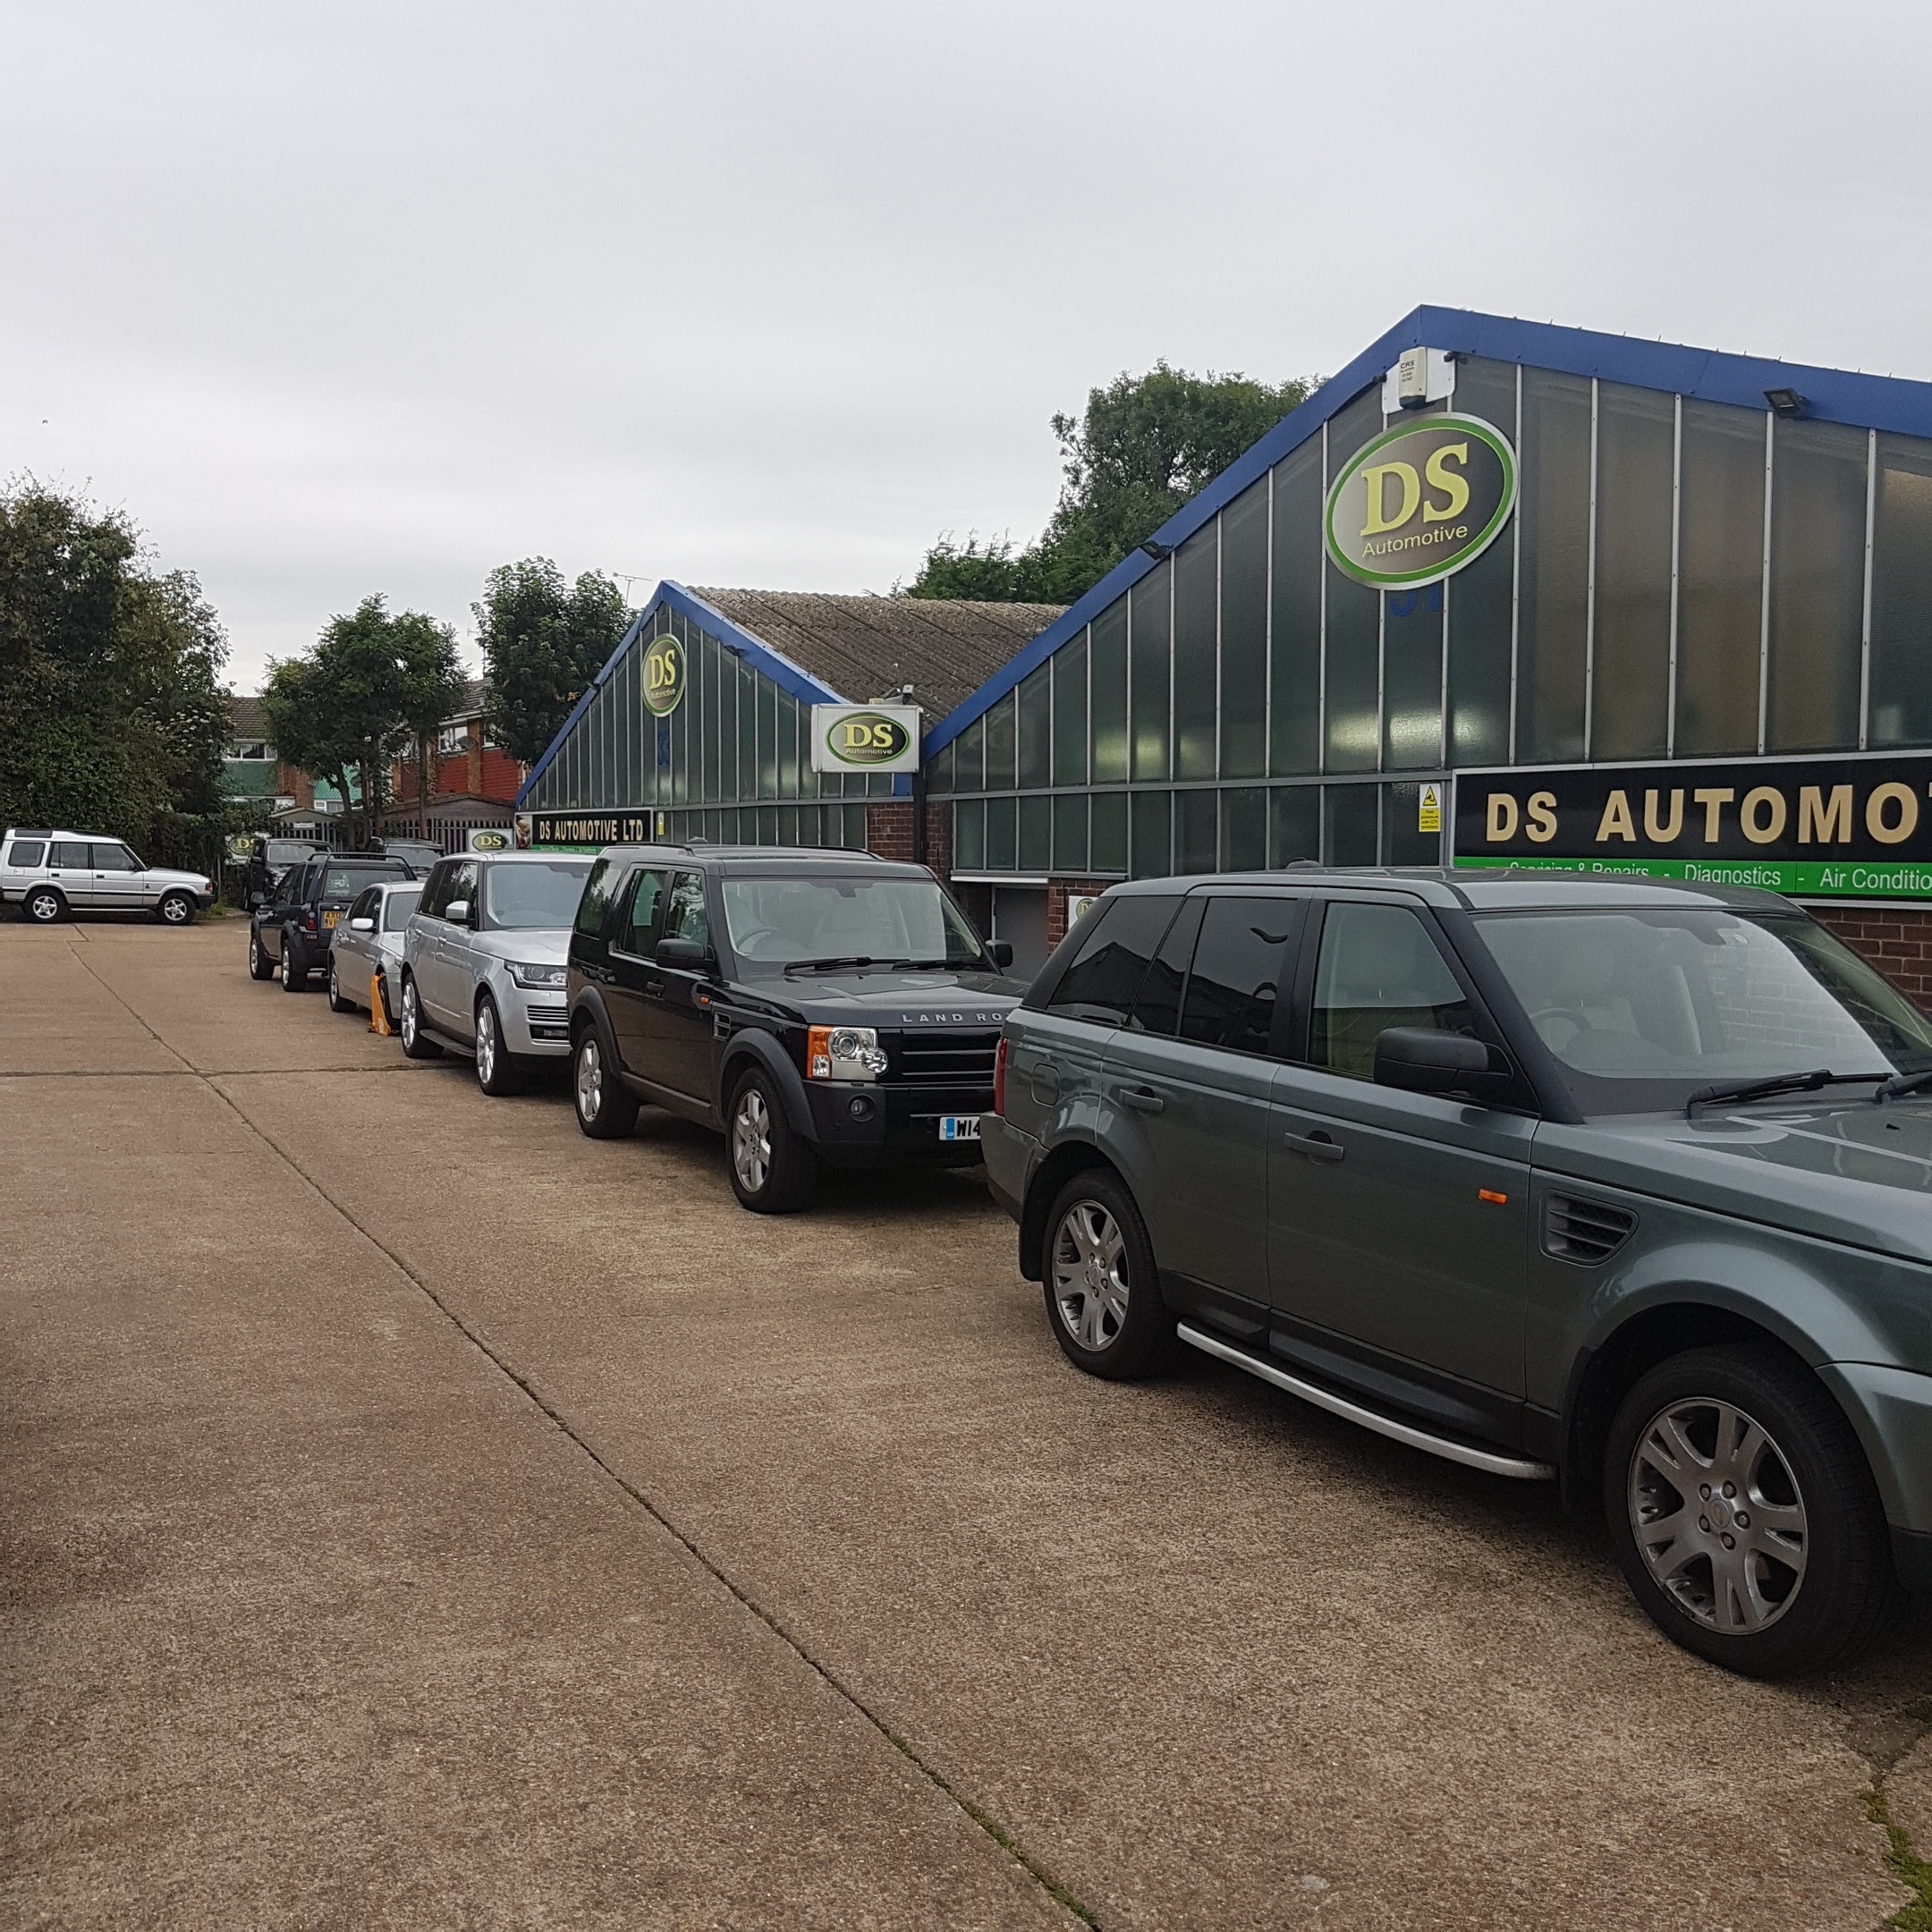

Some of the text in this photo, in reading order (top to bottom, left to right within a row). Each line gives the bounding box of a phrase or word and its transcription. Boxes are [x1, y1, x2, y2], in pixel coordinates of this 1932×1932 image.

[1400, 360, 1415, 369] CRS
[1360, 442, 1470, 537] DS
[1361, 525, 1468, 558] Automotive
[649, 649, 675, 690] DS
[650, 688, 676, 700] Automotive
[843, 724, 894, 749] DS
[1486, 781, 1932, 843] DS AUTOMO
[480, 835, 502, 846] DS
[539, 820, 551, 841] DS
[555, 819, 617, 842] AUTOMOTIVE
[623, 819, 643, 842] LTD
[1684, 864, 1781, 886] Diagnostics
[1819, 869, 1847, 888] Air
[902, 1013, 1009, 1023] LAND RO
